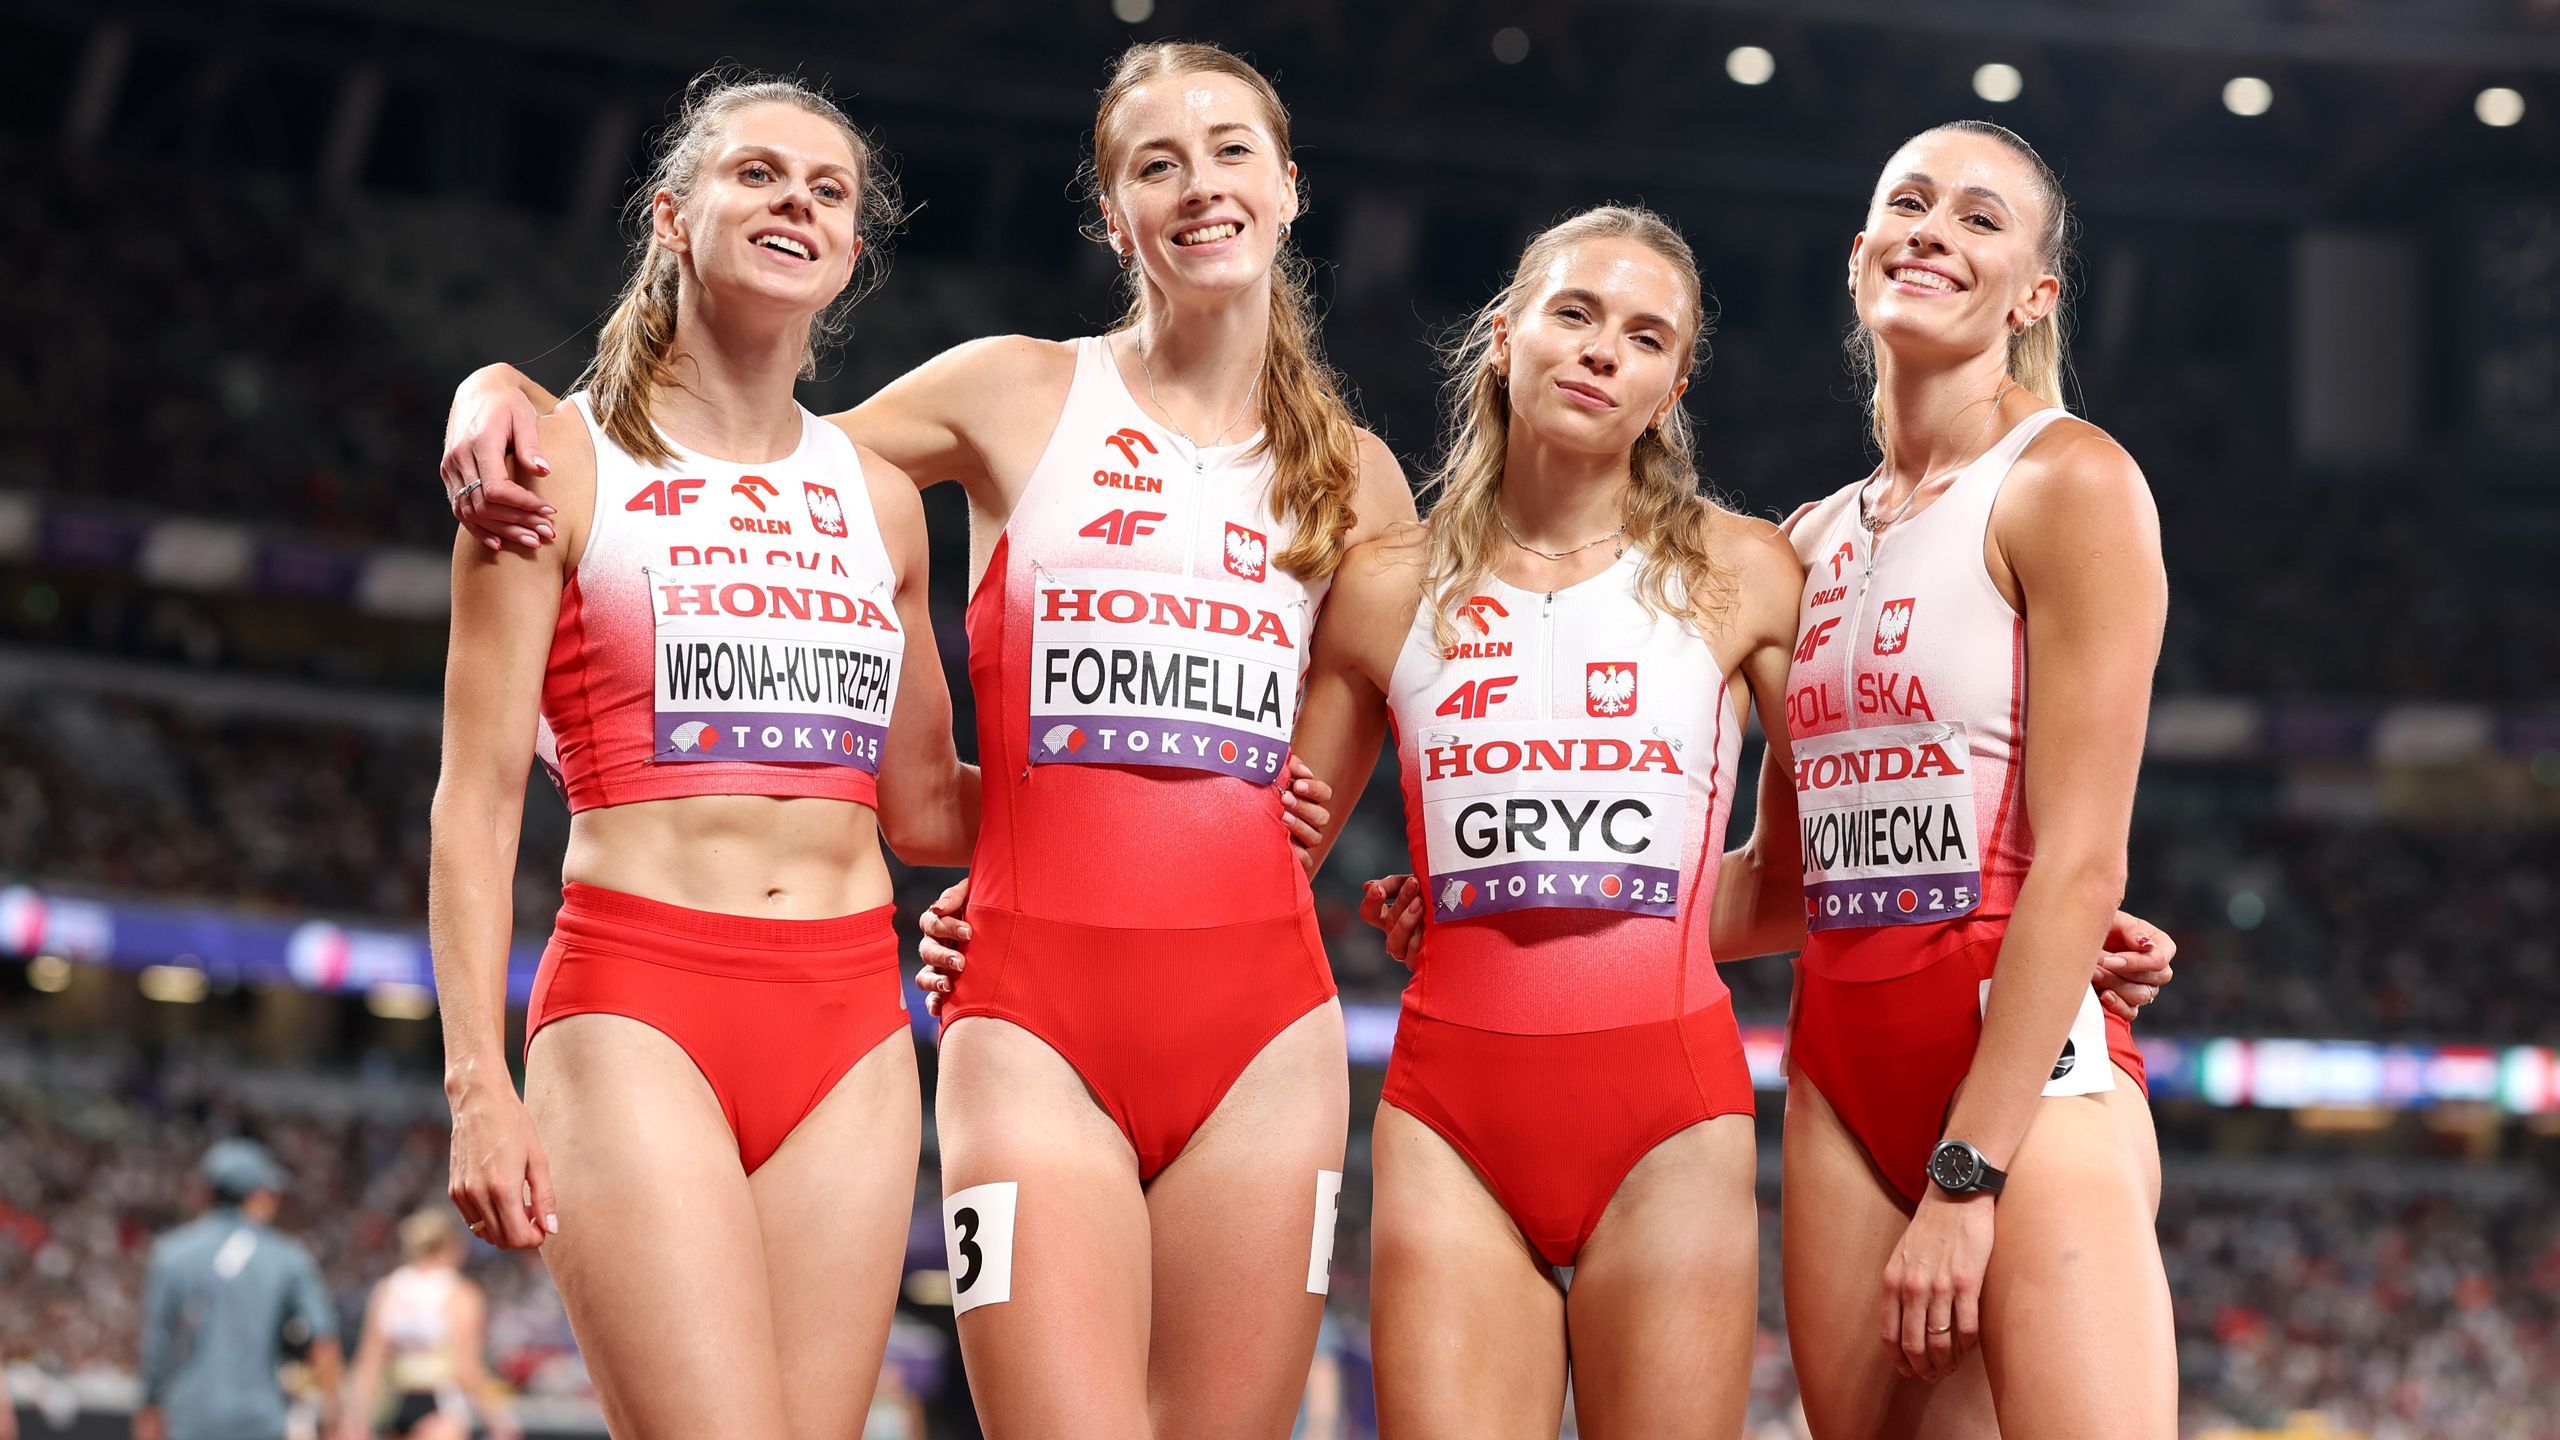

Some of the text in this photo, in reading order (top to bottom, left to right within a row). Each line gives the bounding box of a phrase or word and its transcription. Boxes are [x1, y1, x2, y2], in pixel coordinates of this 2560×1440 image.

[625, 479, 706, 516] 4F
[1093, 469, 1162, 494] ORLEN
[729, 516, 791, 535] ORLEN
[1079, 509, 1167, 546] 4F
[659, 583, 898, 632] HONDA
[1040, 588, 1294, 649] HONDA
[1810, 585, 1847, 608] ORLEN
[1793, 616, 1842, 664] 4F
[666, 642, 891, 714] WRONA-KUTRZEPA
[1045, 648, 1282, 728] FORMELLA
[1436, 675, 1518, 719] 4F
[1425, 739, 1683, 781] HONDA
[1455, 799, 1653, 859] GRYC
[954, 1207, 982, 1294] 3
